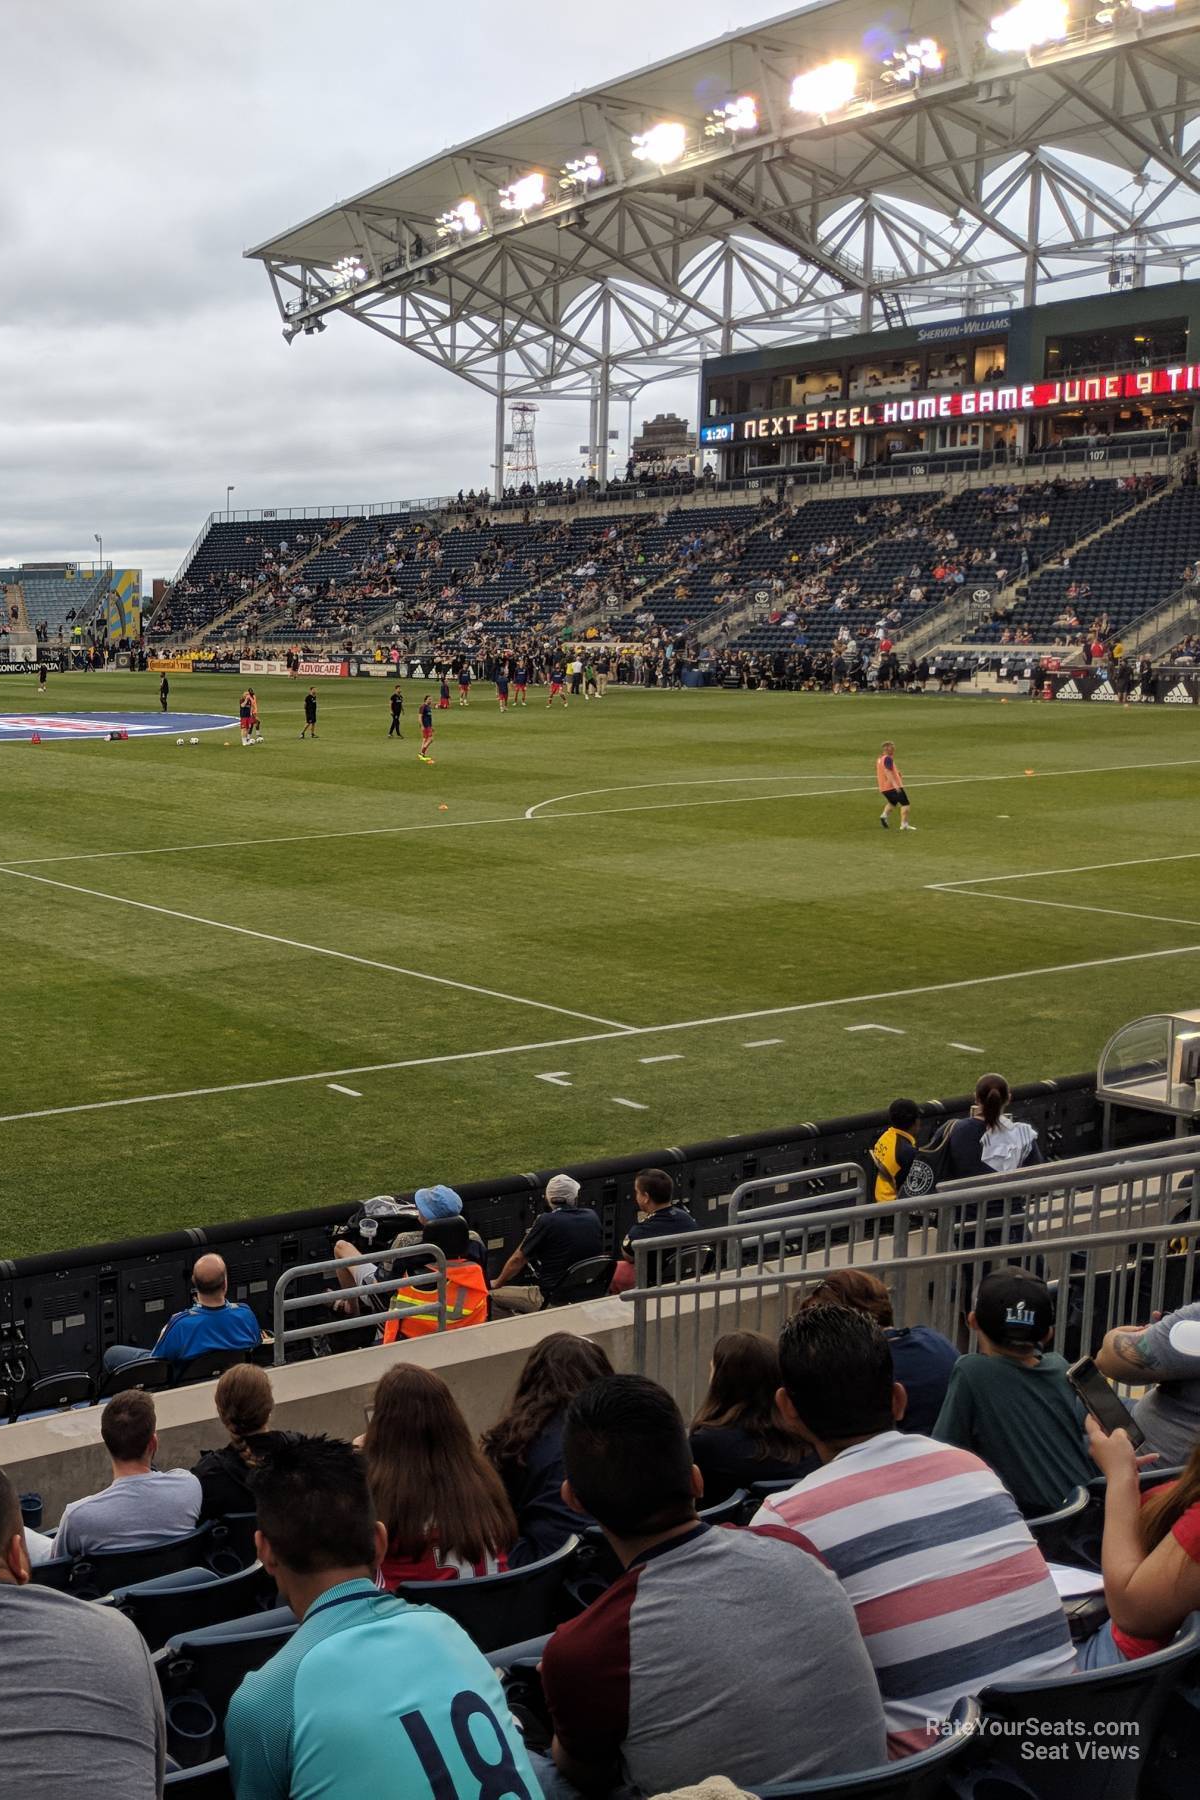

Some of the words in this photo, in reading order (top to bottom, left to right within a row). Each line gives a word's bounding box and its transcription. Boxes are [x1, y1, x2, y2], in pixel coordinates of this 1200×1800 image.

[918, 319, 1009, 340] SHERWIN-WILLIAMS
[744, 415, 798, 439] NEXT
[805, 406, 875, 432] STEEL
[884, 396, 951, 423] HOME
[961, 386, 1035, 414] GAME
[1048, 376, 1119, 404] JUNE
[1136, 372, 1153, 394] 9
[1167, 365, 1200, 391] TI
[706, 428, 728, 440] 1:20
[1089, 451, 1105, 461] 107
[911, 466, 925, 475] 106
[748, 480, 759, 489] 105
[28, 663, 59, 671] MINLTA
[300, 662, 341, 674] ADVOCARE
[1056, 692, 1082, 700] adidas
[1164, 695, 1193, 704] adidas
